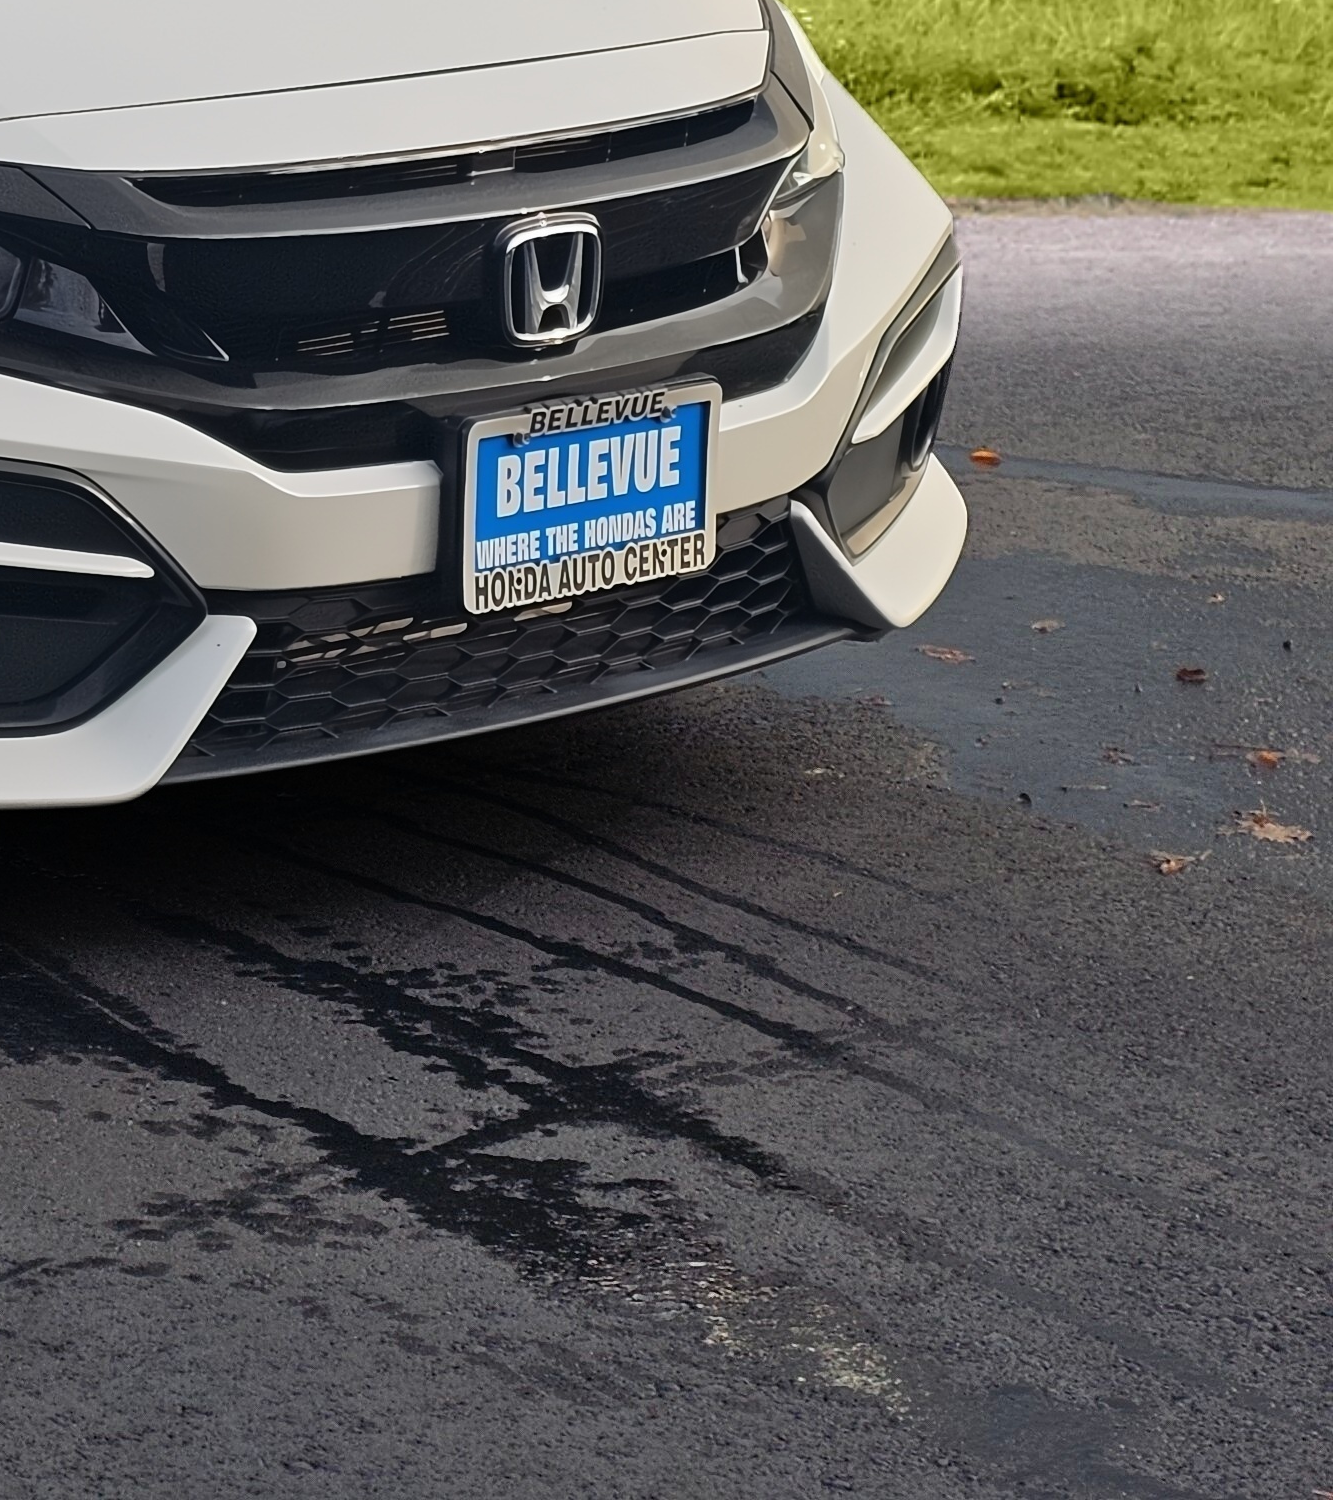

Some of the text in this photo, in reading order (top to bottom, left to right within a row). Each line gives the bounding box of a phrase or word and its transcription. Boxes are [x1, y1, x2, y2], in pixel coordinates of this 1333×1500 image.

[530, 391, 666, 434] BELLEVUE
[496, 425, 682, 519] BELLEVUE
[474, 532, 706, 611] HONDA AUTO CENTER
[476, 499, 697, 570] WHERE THE HONDAS ARE
